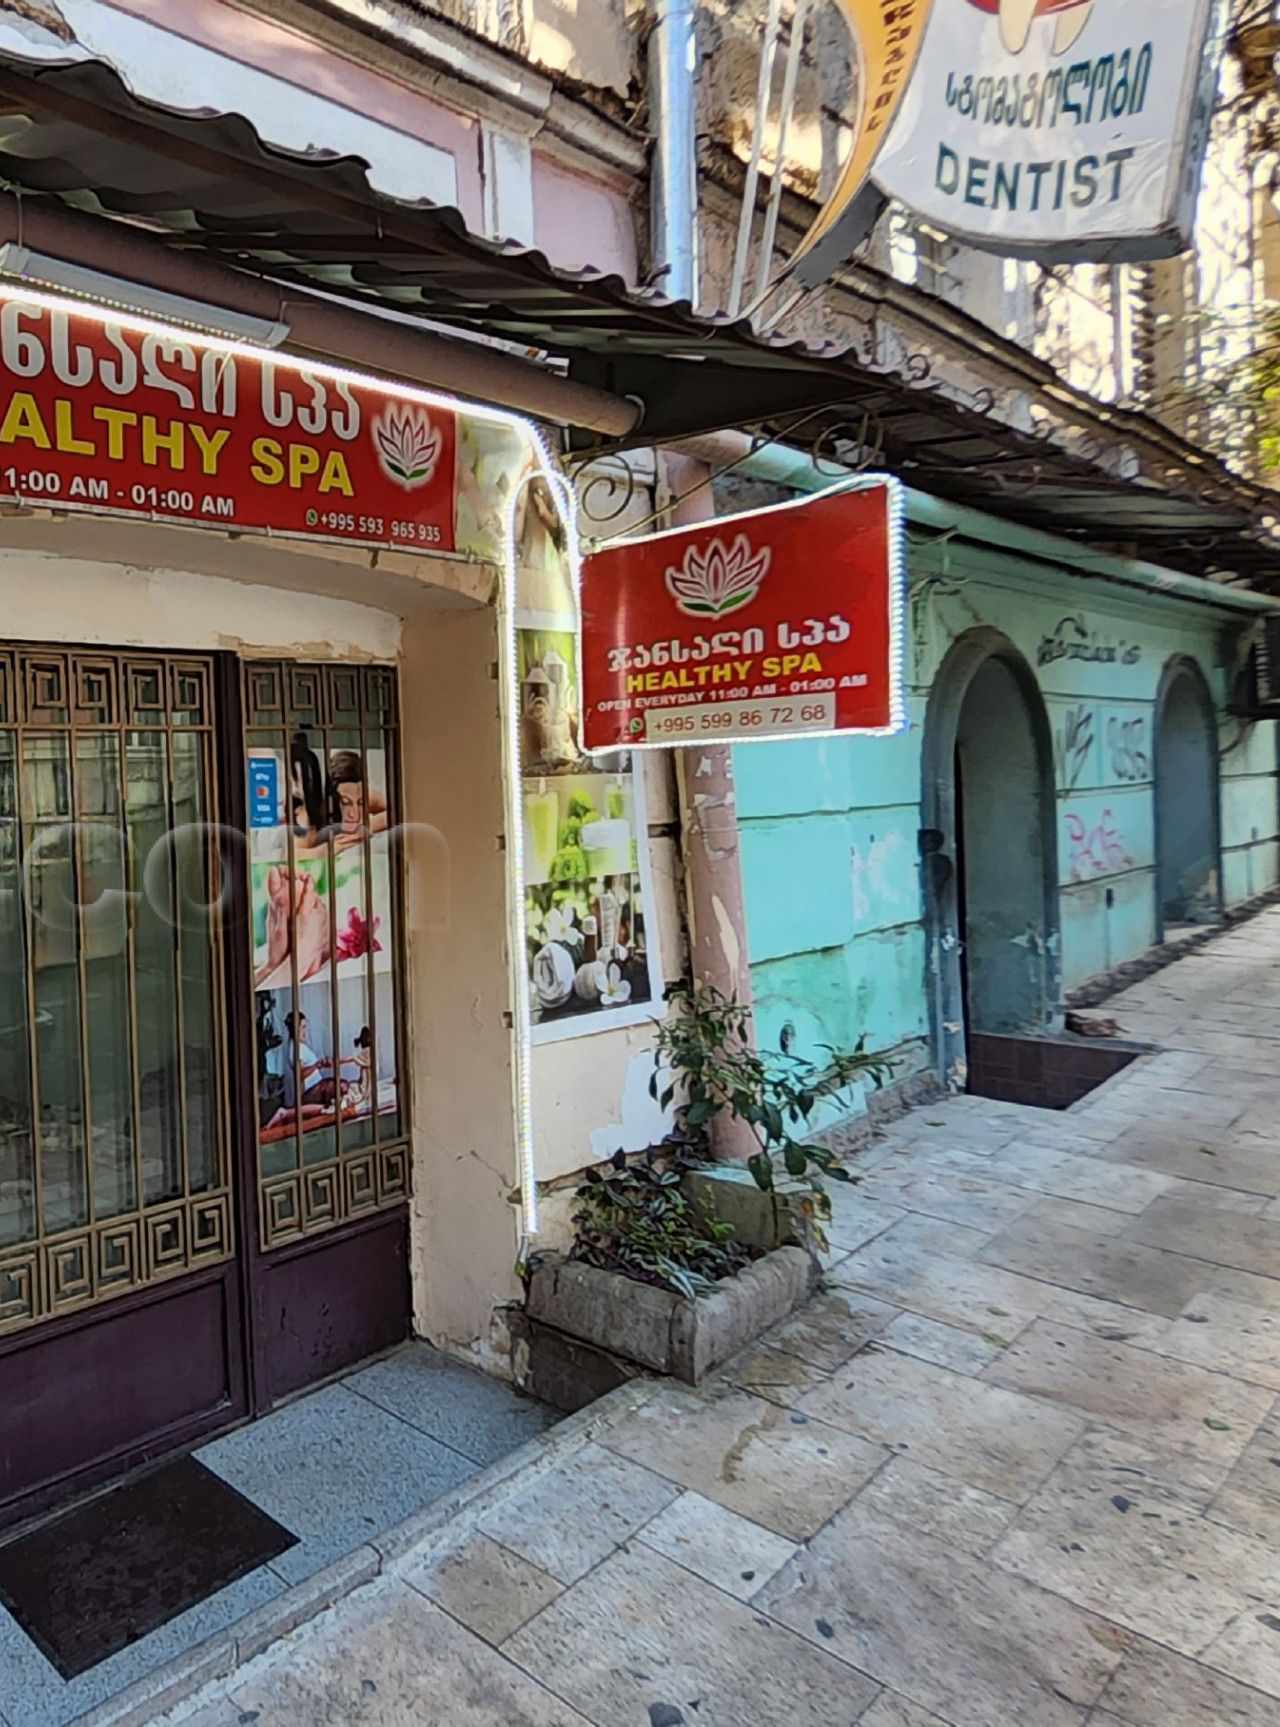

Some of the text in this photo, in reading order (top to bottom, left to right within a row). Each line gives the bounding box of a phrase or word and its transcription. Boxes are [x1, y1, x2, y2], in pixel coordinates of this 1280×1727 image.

[935, 141, 1135, 211] DENTIST
[251, 437, 355, 497] SPA
[69, 474, 109, 500] AM
[132, 485, 193, 511] 01:00
[200, 496, 235, 517] AM
[321, 513, 440, 542] +995 593 965 935
[607, 614, 851, 672] ჯანსაღი სპა
[597, 698, 631, 712] OPEN
[634, 691, 704, 709] EVERYDAY
[709, 686, 748, 700] 11:00
[752, 684, 776, 697] AM
[790, 678, 835, 692] 01:00
[839, 674, 868, 687] AM
[626, 652, 822, 693] HEALTHY SPA
[654, 704, 826, 733] +995 599 86 72 68
